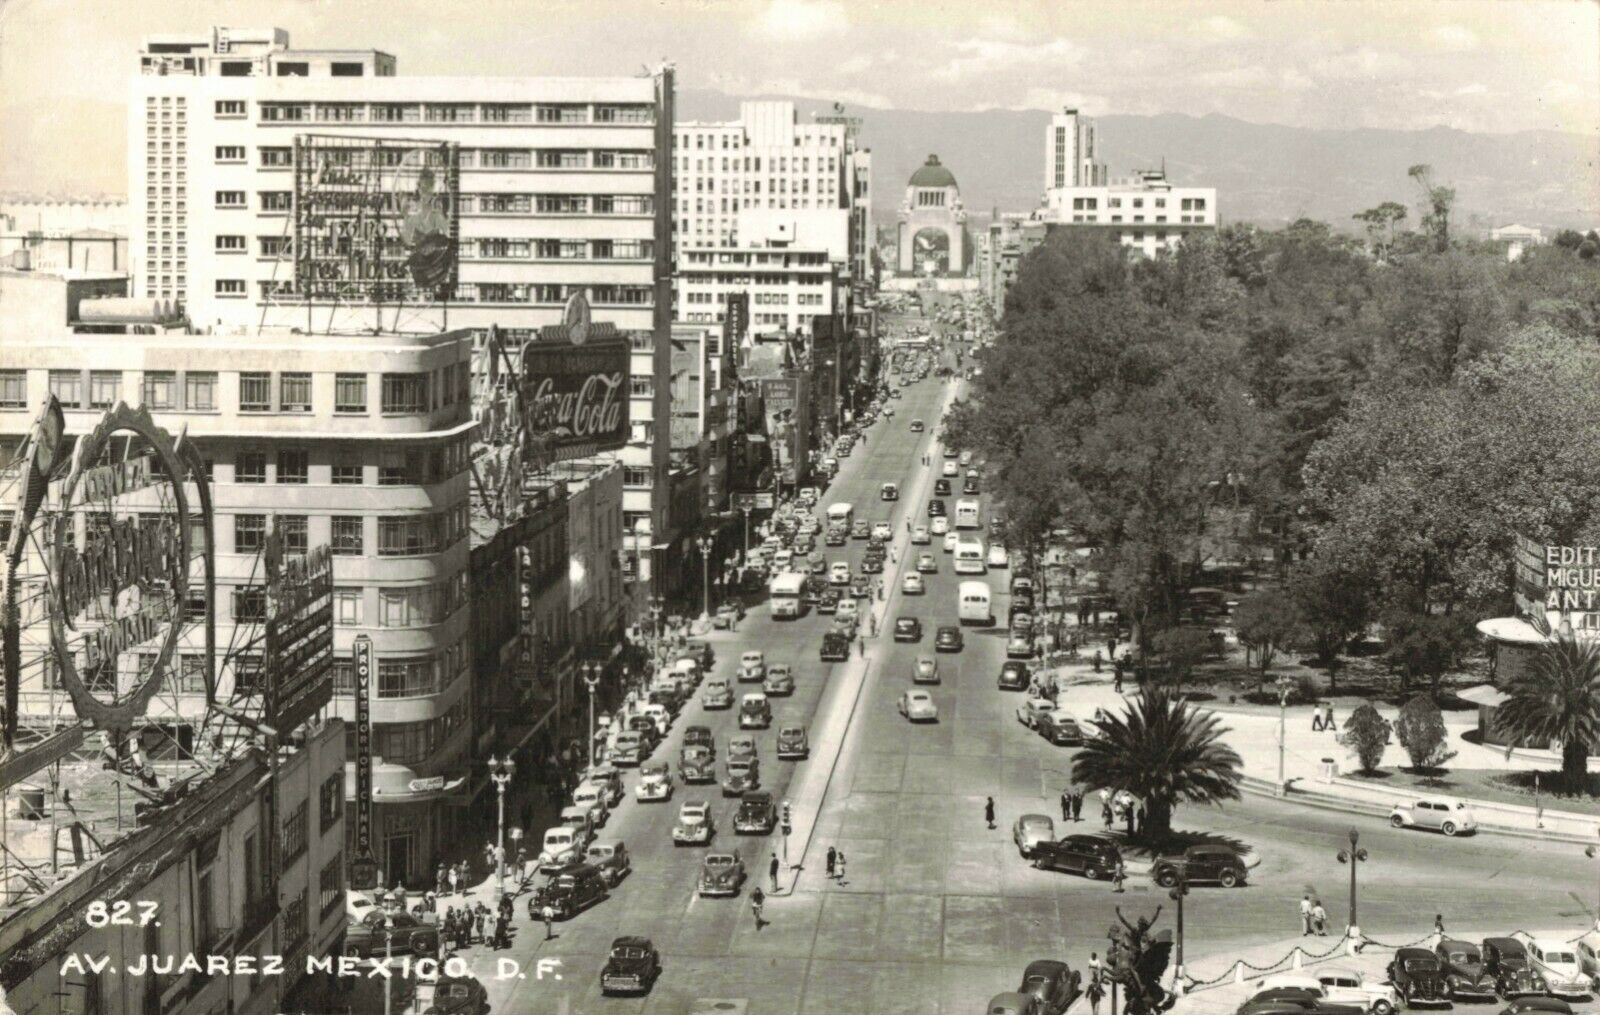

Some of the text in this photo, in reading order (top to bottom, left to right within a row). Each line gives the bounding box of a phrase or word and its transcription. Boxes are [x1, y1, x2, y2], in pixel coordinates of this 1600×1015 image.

[528, 371, 624, 436] Ca-Cola
[1546, 546, 1597, 565] EDIT
[1547, 568, 1600, 587] MIGUE
[1546, 590, 1597, 609] ANT
